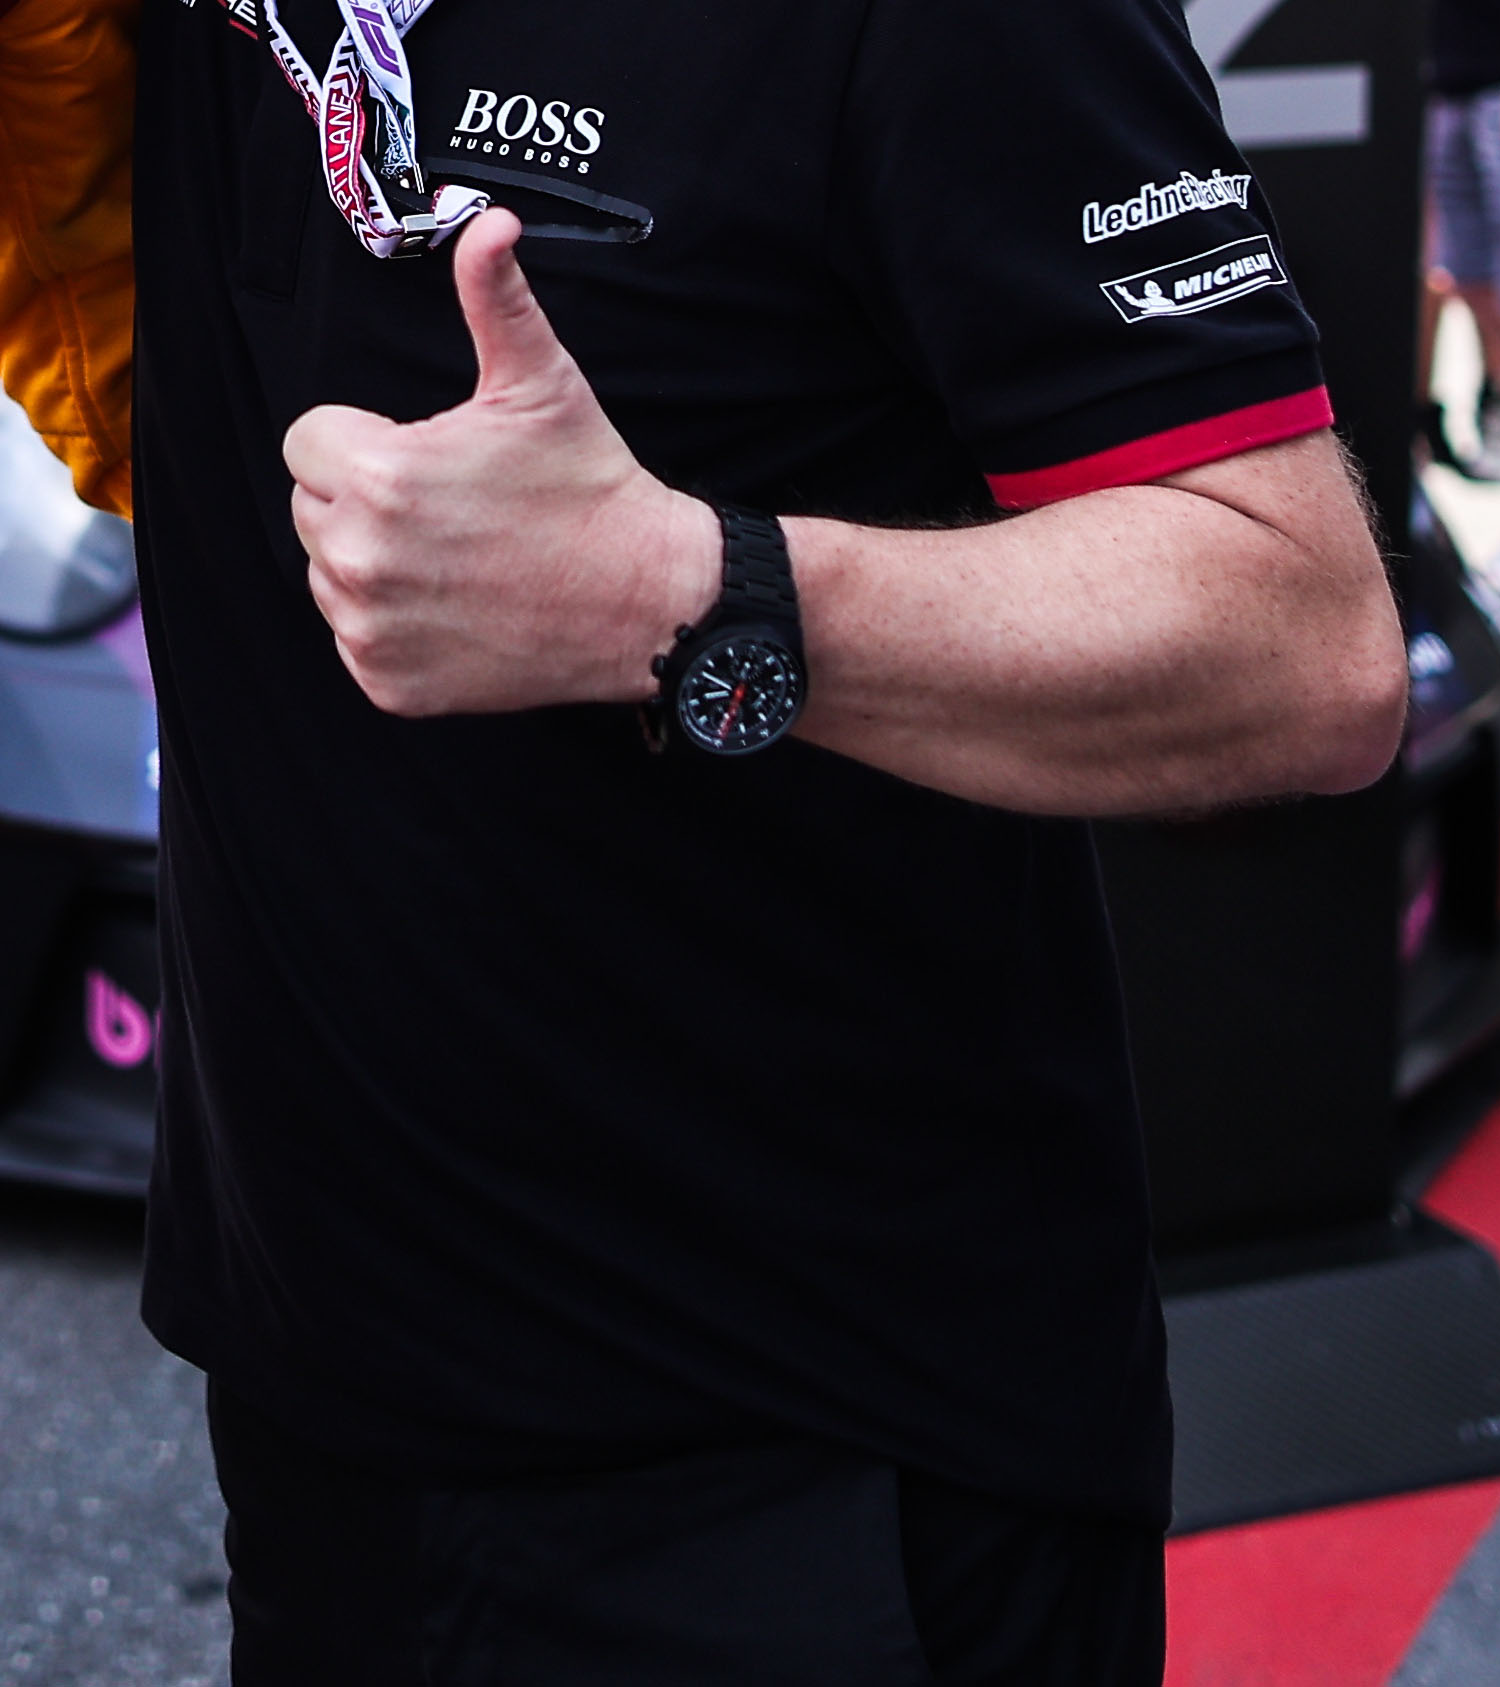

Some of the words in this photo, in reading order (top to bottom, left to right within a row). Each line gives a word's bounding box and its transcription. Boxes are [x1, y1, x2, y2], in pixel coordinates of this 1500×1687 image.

[328, 92, 354, 162] LANE
[454, 89, 605, 155] BOSS
[450, 135, 510, 156] HUGO
[524, 148, 590, 174] BOSS
[329, 163, 354, 212] PIT
[1173, 252, 1273, 300] MICHELIN
